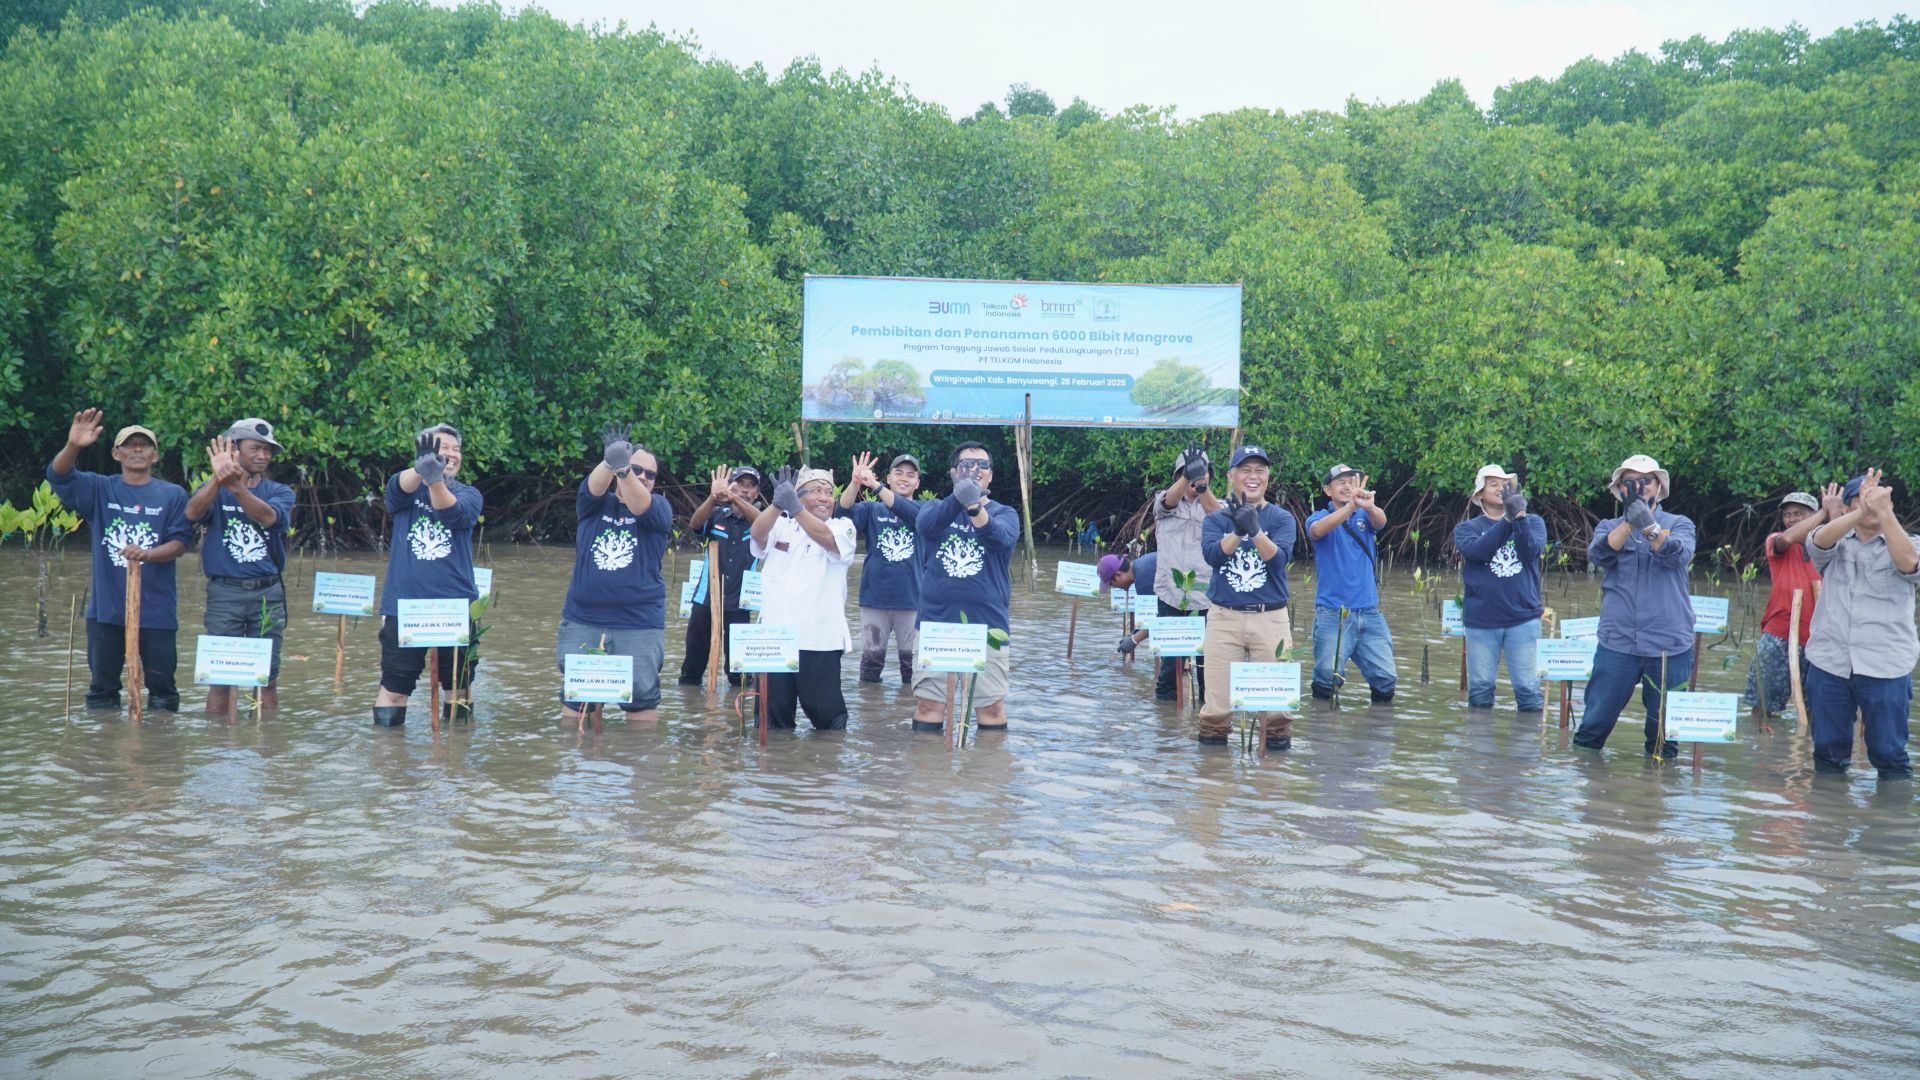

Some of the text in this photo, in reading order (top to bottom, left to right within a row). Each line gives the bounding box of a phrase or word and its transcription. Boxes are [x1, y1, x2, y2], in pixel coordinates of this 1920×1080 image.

[928, 301, 970, 315] BUMN
[982, 302, 1008, 310] Telkom
[1041, 299, 1076, 313] bmm
[985, 310, 1021, 318] Indonesia
[851, 325, 1193, 346] Pembibitan dan Penanaman 6000 Bibit Mangrove
[903, 343, 1139, 357] Program Tanggung Jawab Sosial Peduli Lingkungan (TJSL)
[978, 356, 1062, 366] PT TELKOM Indonesia
[933, 374, 986, 385] Wringinputih
[987, 376, 1005, 385] Kab.
[1006, 377, 1059, 388] Banyuwangi,
[1072, 378, 1106, 387] Februari
[1106, 378, 1127, 387] 2025
[318, 591, 347, 599] Karyawan
[923, 646, 957, 654] Karyawan
[1235, 685, 1270, 693] Karyawan
